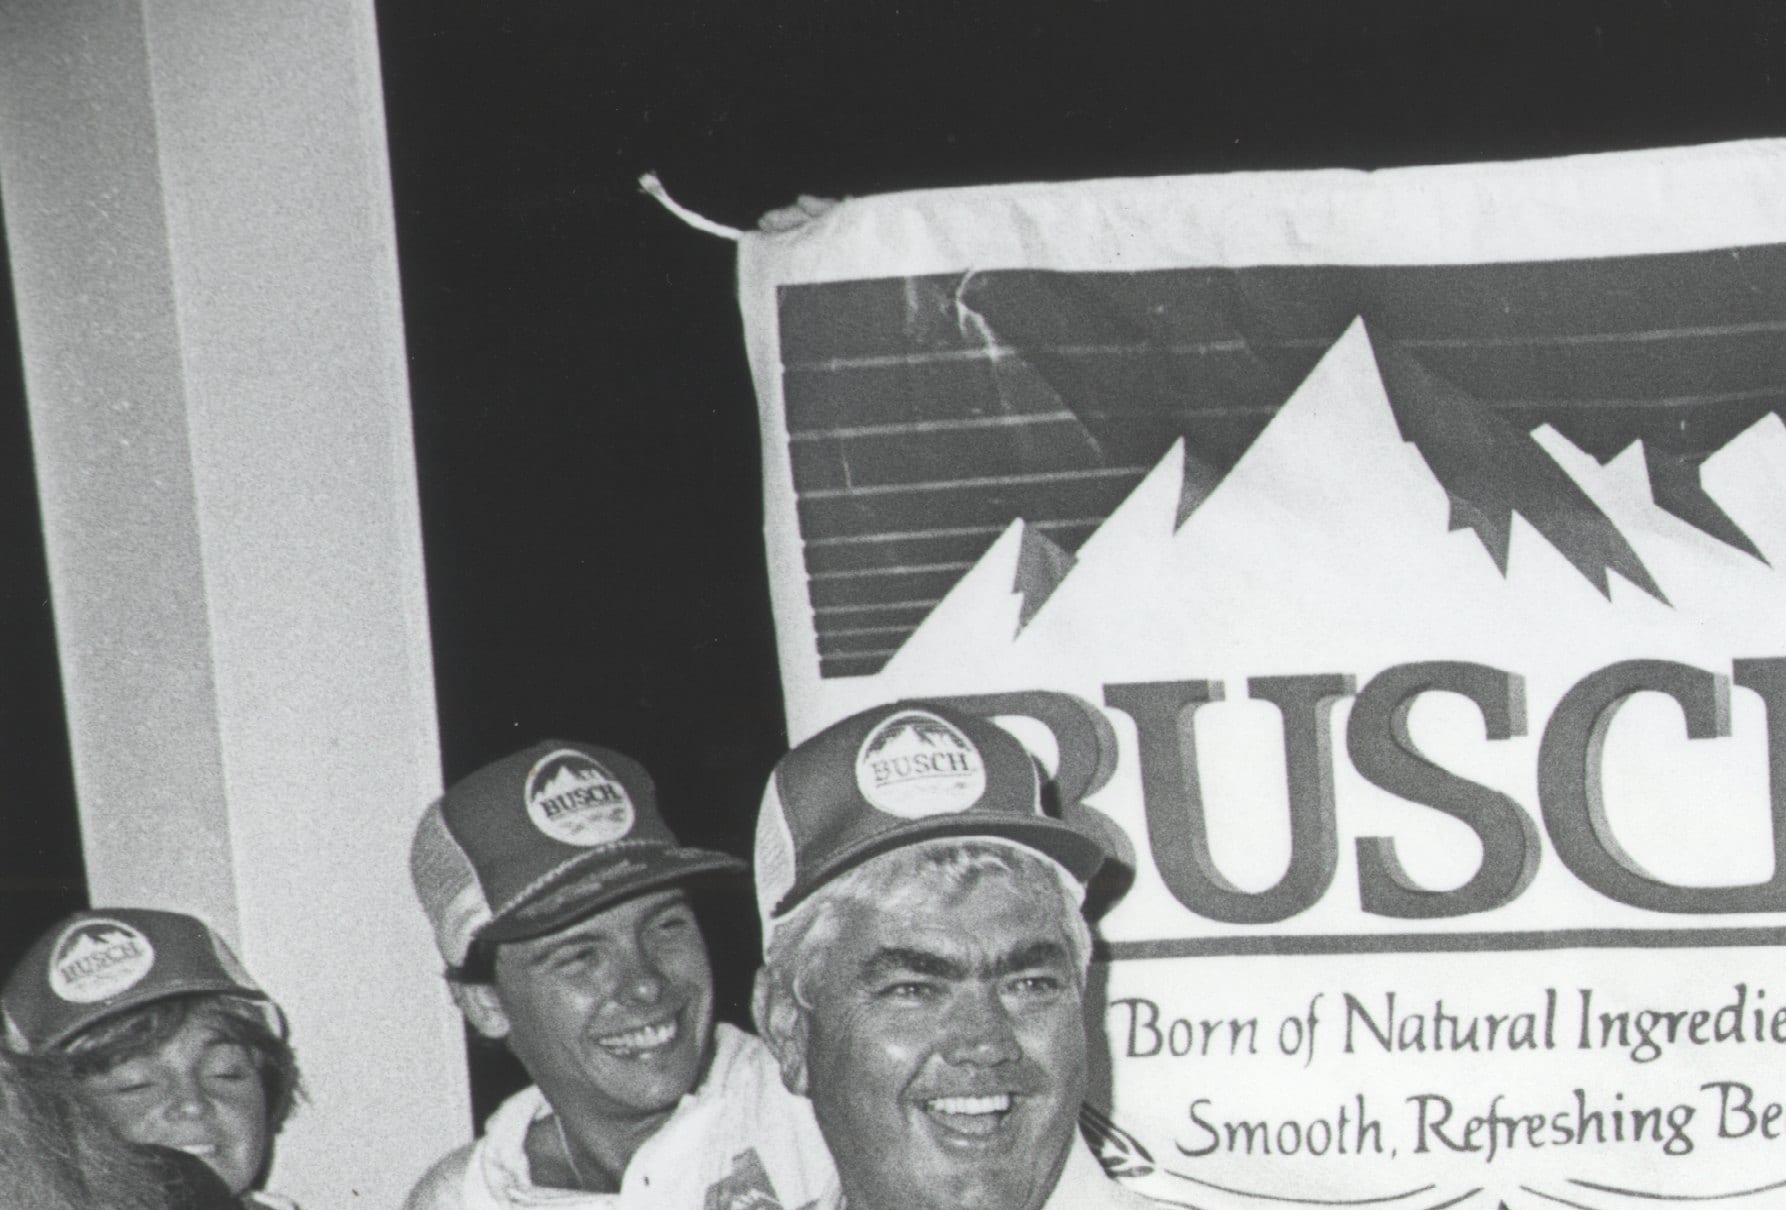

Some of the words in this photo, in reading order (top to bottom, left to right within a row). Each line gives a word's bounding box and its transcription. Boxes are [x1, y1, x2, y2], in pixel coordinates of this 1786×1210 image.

[871, 751, 970, 782] BUSCH
[541, 783, 622, 818] BUSCH
[1110, 997, 1258, 1057] Born
[1279, 992, 1325, 1069] of
[1342, 987, 1558, 1056] Natural
[1175, 1093, 1398, 1160] Smooth,
[1405, 1088, 1696, 1163] Refreshing
